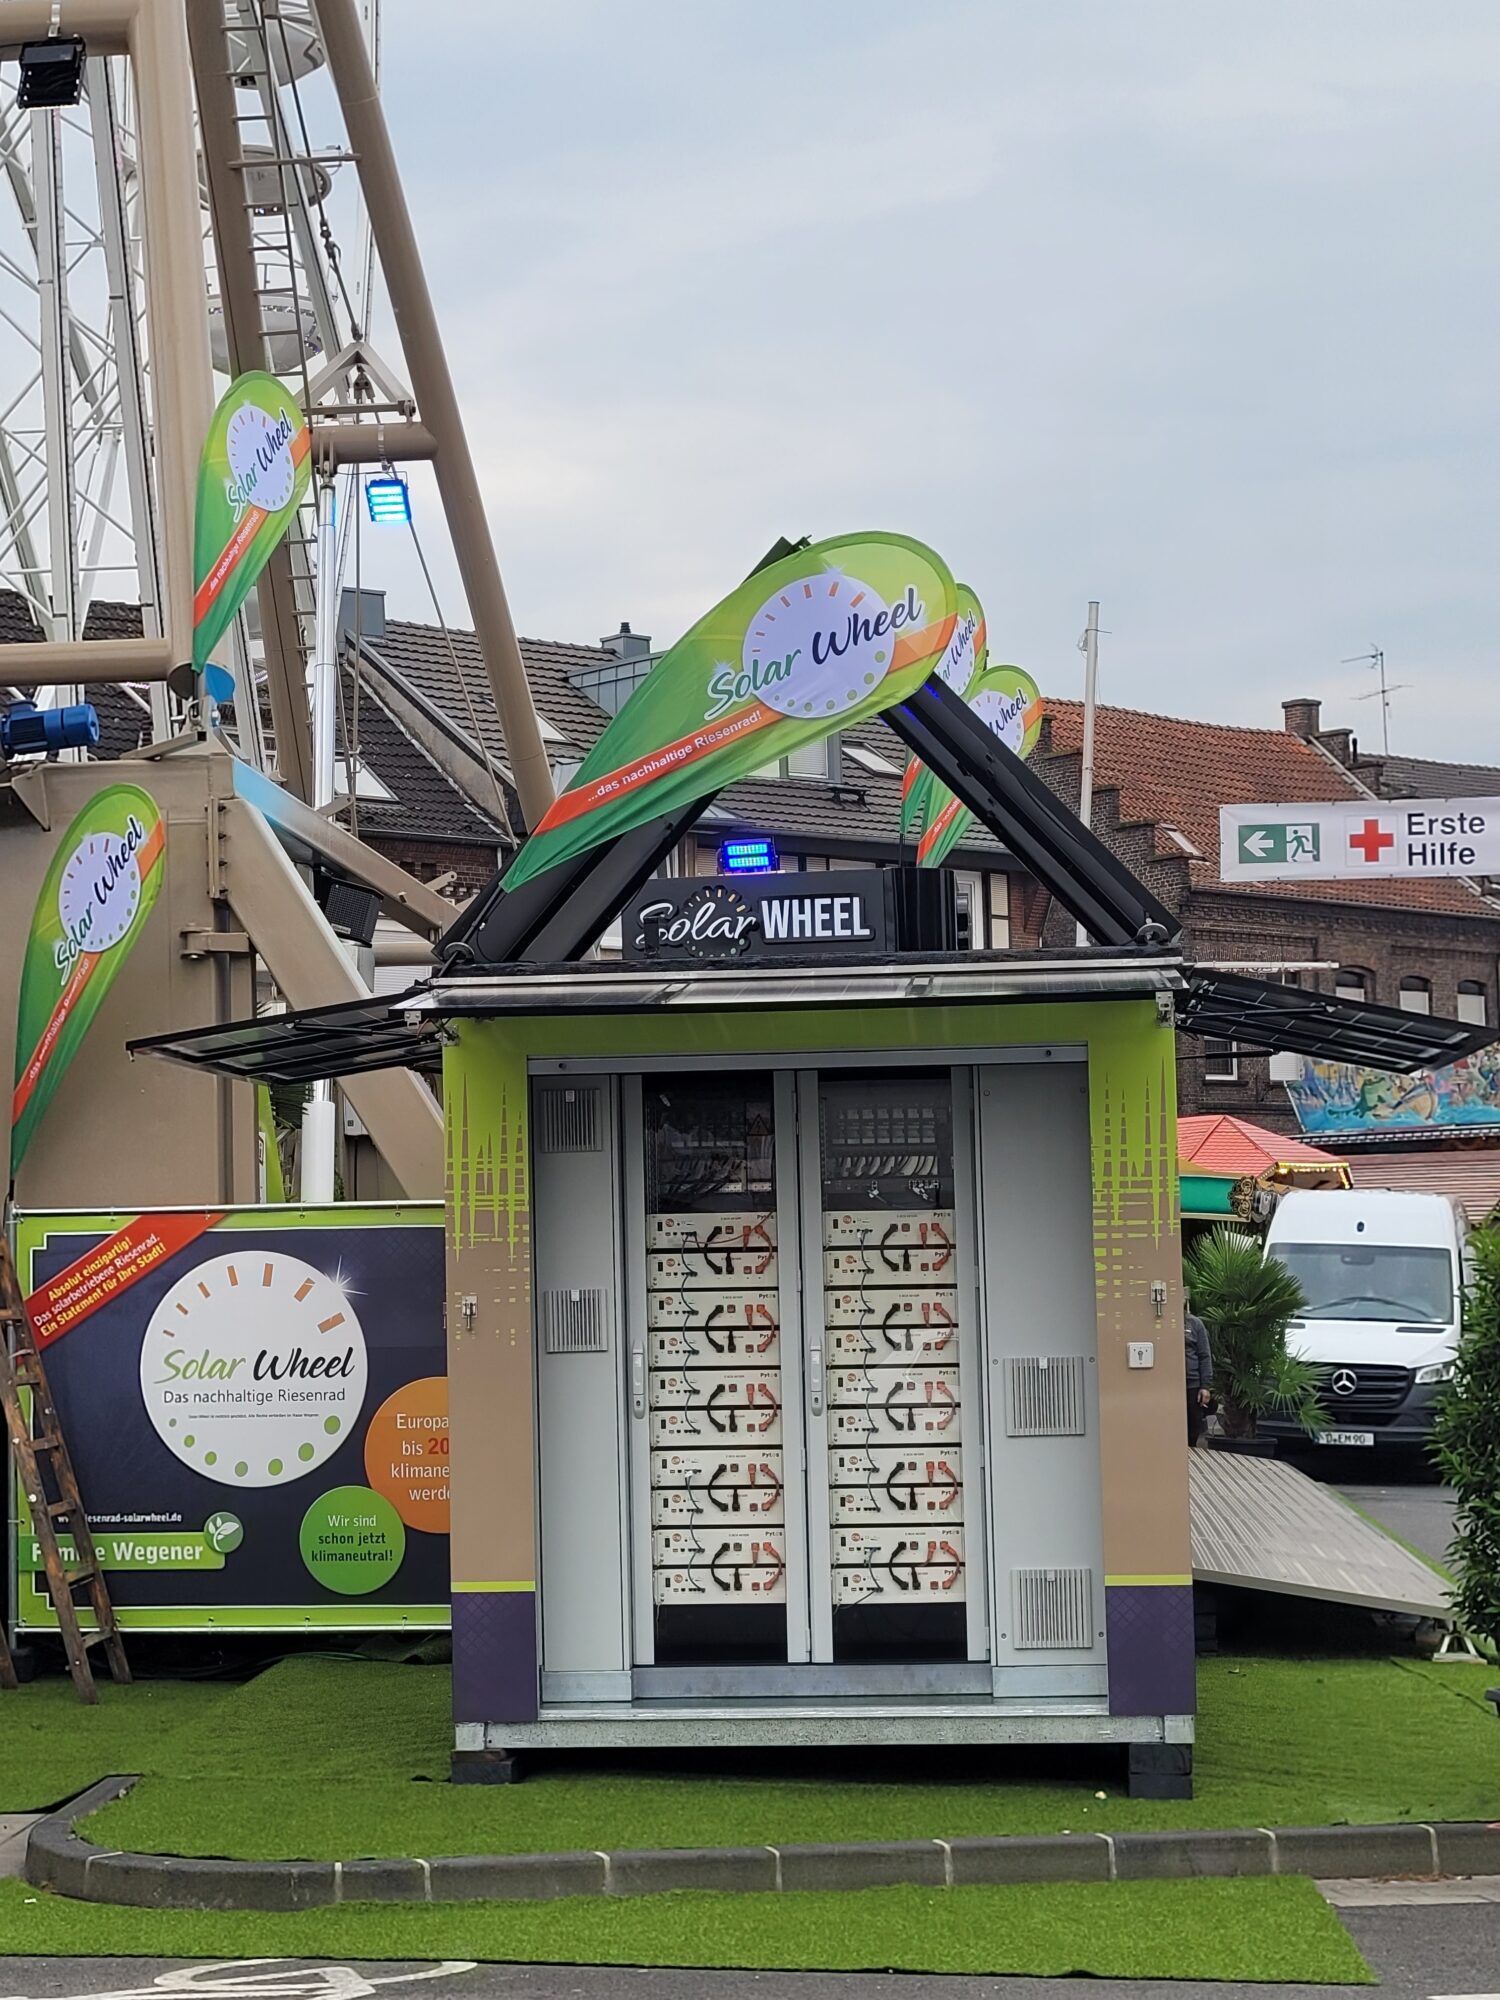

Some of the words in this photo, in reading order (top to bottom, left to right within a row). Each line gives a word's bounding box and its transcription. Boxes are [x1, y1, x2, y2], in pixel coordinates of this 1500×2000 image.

[228, 462, 257, 521] Solar
[256, 408, 292, 472] Wheel
[705, 647, 802, 720] Solar
[811, 587, 922, 665] Wheel
[951, 609, 976, 665] Wheel
[988, 688, 1027, 735] Wheel
[622, 743, 693, 785] nachhaltige
[694, 709, 762, 749] Riesenrad!
[1407, 812, 1486, 837] Erste
[1407, 842, 1476, 867] Hilfe
[56, 901, 93, 985] Solar
[94, 816, 143, 905] Wheel
[635, 901, 757, 945] Solar
[761, 896, 871, 939] WHEEL
[33, 1311, 52, 1327] Das
[51, 1265, 115, 1314] solarbetriebene
[113, 1233, 160, 1268] Riesenrad.
[40, 1320, 58, 1337] Ein
[56, 1288, 104, 1325] Statement
[102, 1278, 118, 1292] für
[117, 1264, 138, 1282] Ihre
[136, 1242, 166, 1268] Stadt!
[48, 1273, 83, 1301] Absolut
[82, 1236, 133, 1277] einzigartig!
[153, 1348, 246, 1385] Solar
[253, 1346, 355, 1381] Wheel
[163, 1390, 189, 1404] Das
[193, 1389, 273, 1406] nachhaltige
[278, 1387, 346, 1402] Riesenrad
[396, 1413, 449, 1431] Europa
[402, 1440, 423, 1456] bis
[318, 1532, 354, 1545] schon
[357, 1532, 386, 1547] jetzt
[327, 1514, 350, 1527] Wir
[353, 1514, 377, 1527] sind
[112, 1541, 203, 1565] Wegener
[311, 1549, 393, 1562] klimaneutral!
